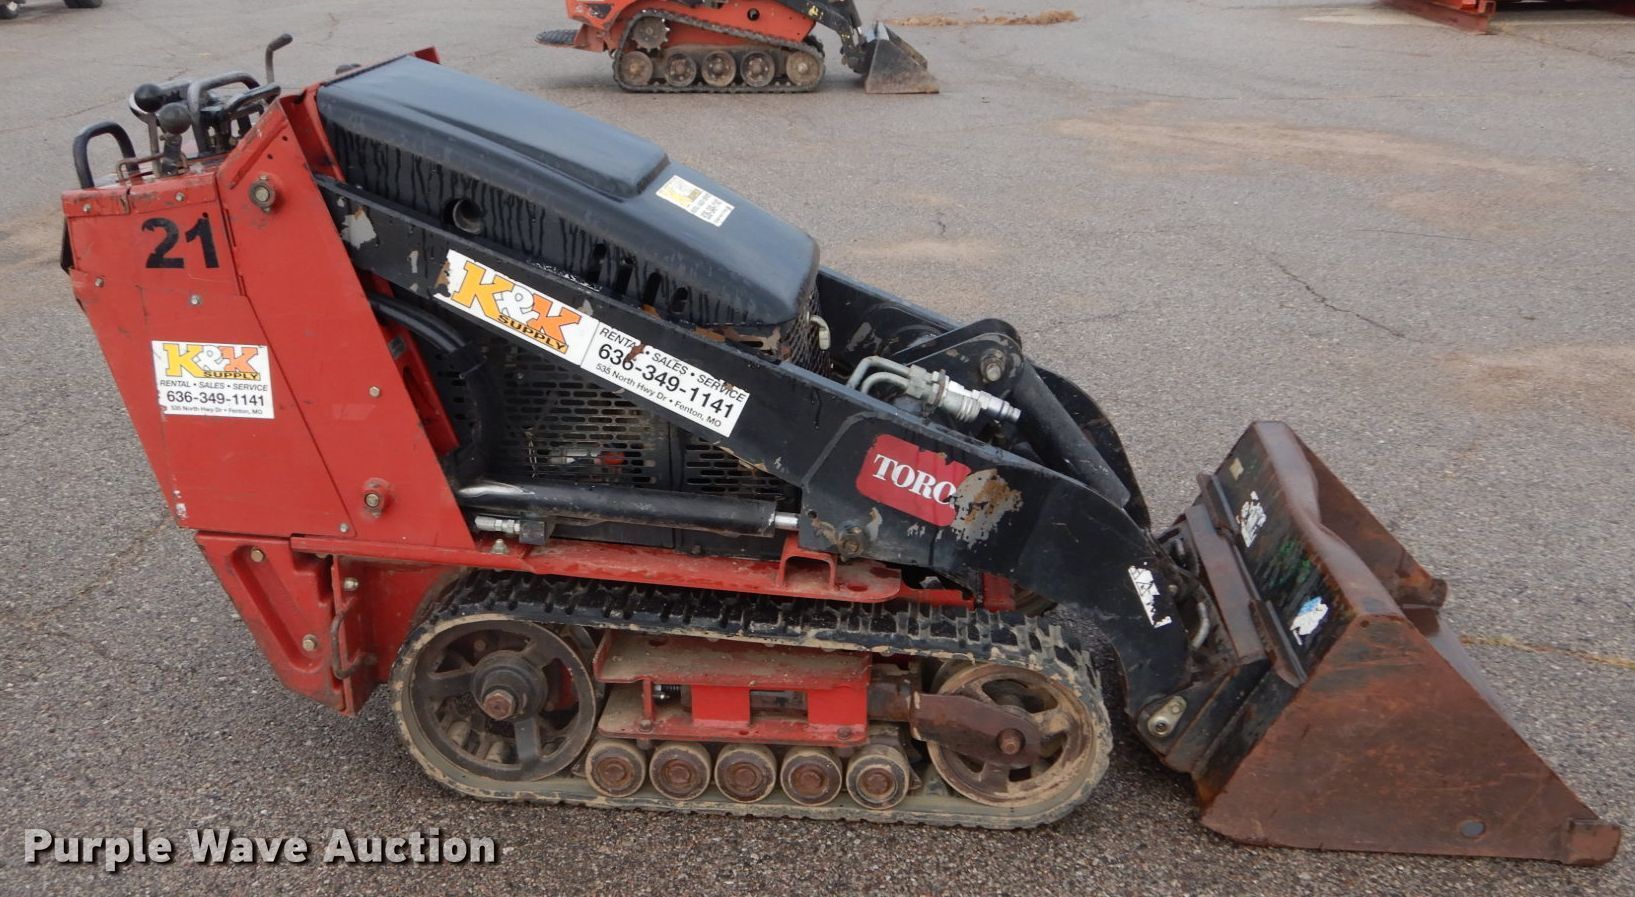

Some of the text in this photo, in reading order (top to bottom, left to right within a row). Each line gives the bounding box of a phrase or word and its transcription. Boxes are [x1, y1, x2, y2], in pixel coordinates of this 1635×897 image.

[141, 214, 220, 269] 21
[451, 260, 582, 344] K&K
[497, 314, 567, 351] SUPPLY
[163, 343, 258, 378] K&K
[203, 371, 259, 381] SUPPLY
[598, 343, 734, 419] 636-349-1141
[600, 327, 746, 403] RENTA SALES SERVICE
[160, 379, 268, 392] RENTAL SALES SERVICE
[166, 390, 265, 407] 636-349-1141
[595, 363, 722, 428] 535 North Hwy Dr Fenton, MO
